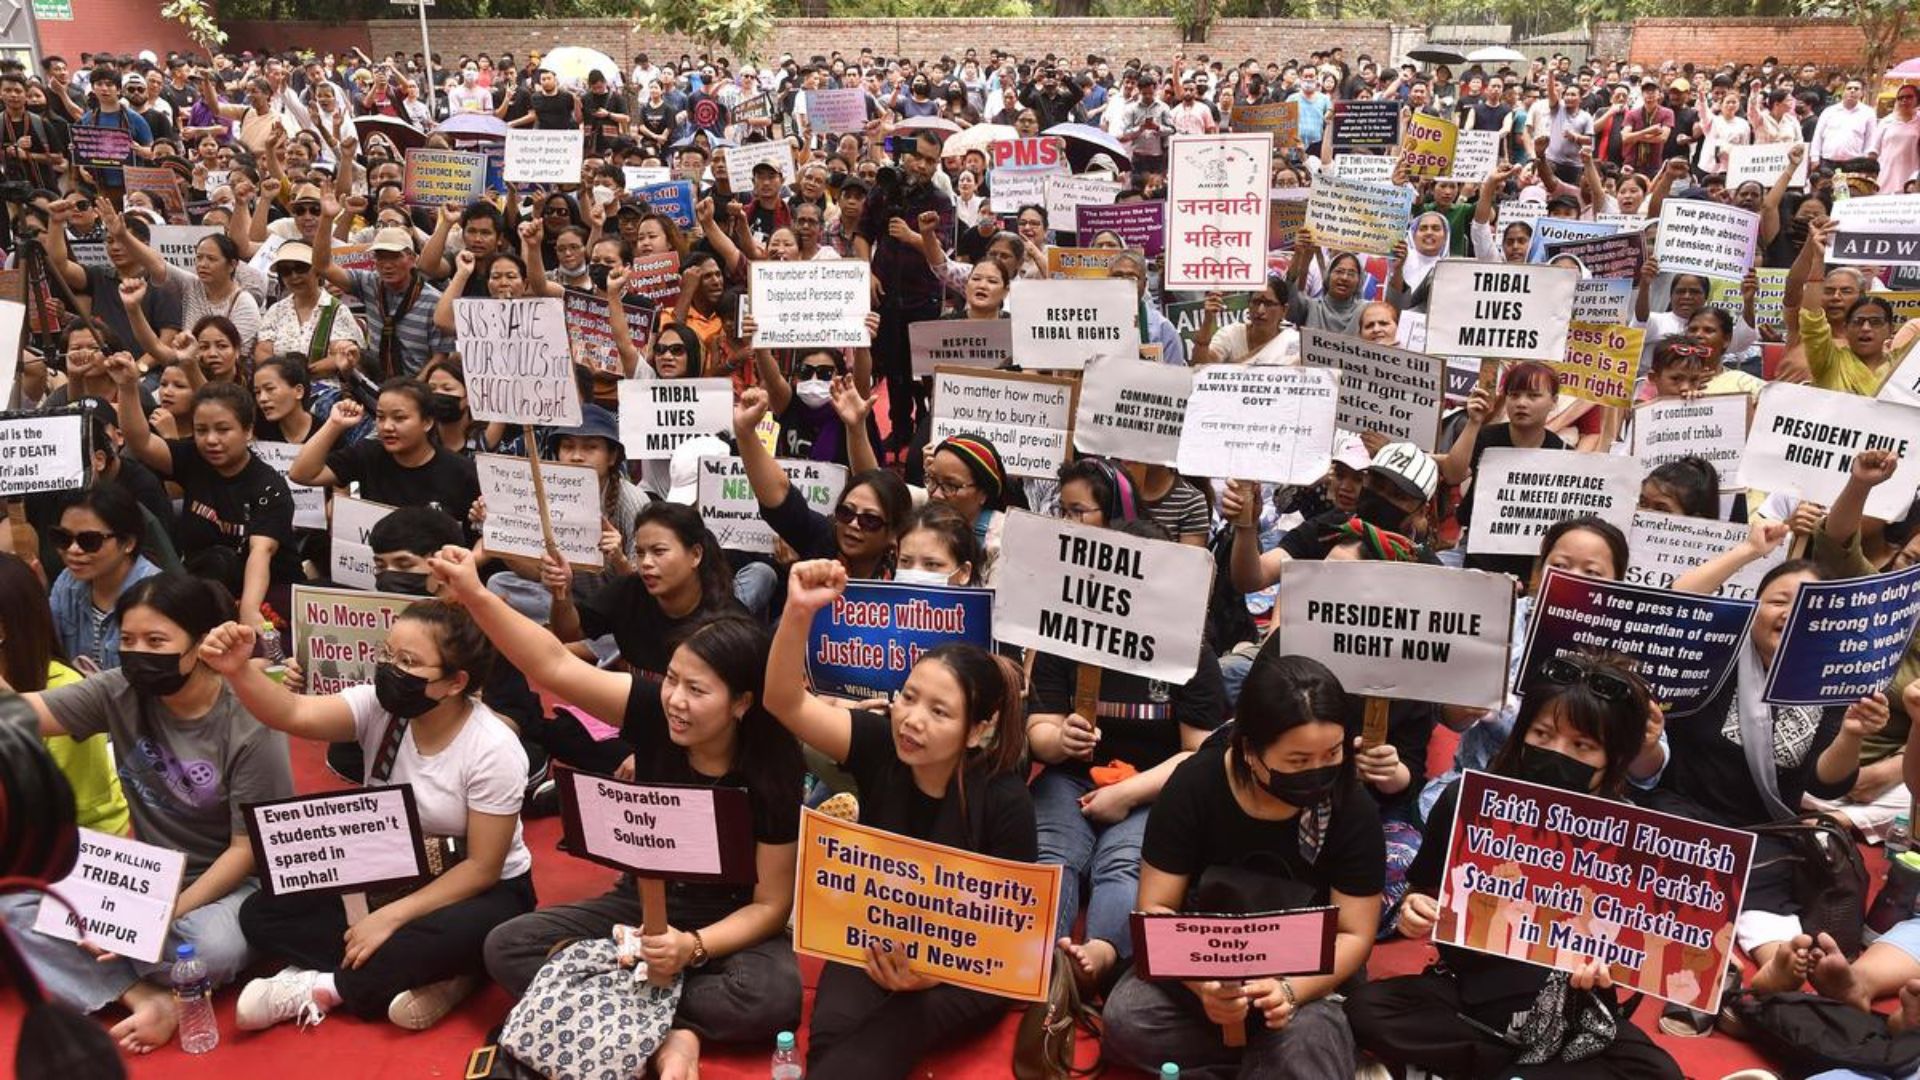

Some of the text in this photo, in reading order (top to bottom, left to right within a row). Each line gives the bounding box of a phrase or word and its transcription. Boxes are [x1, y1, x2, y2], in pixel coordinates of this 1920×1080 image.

[994, 137, 1058, 167] PMS
[1177, 192, 1261, 216] जनवादी
[1676, 206, 1696, 218] True
[1699, 210, 1726, 223] peace
[1728, 215, 1735, 224] is
[1184, 225, 1253, 248] महिला
[1666, 223, 1698, 236] merely
[1700, 225, 1716, 236] the
[633, 259, 673, 273] Freedom
[1182, 257, 1252, 280] समिति
[1660, 253, 1703, 266] presence
[1704, 258, 1713, 268] of
[758, 267, 864, 281] The number of Internally
[1473, 272, 1531, 293] TRIBAL
[767, 288, 807, 302] Displaced
[809, 288, 842, 300] Persons
[1047, 308, 1098, 321] RESPECT
[1475, 301, 1522, 320] LIVES
[1032, 326, 1121, 340] TRIBAL RIGHTS
[1458, 327, 1539, 349] MATTERS
[1312, 336, 1430, 373] Resistance till
[1307, 353, 1436, 391] our last breath!
[651, 386, 699, 403] TRIBAL
[942, 381, 1064, 405] No matter how much
[1368, 379, 1435, 408] fight for
[1585, 376, 1628, 399] right.
[657, 410, 694, 427] LIVES
[953, 406, 1036, 425] you try to bury
[1116, 416, 1154, 433] AGAINST
[1773, 416, 1861, 448] PRESIDENT
[20, 445, 57, 457] DEATH
[1, 478, 80, 492] Compensation
[1507, 472, 1605, 490] REMOVE/REPLACE
[1497, 489, 1613, 508] ALL MEETEI OFFICERS
[1500, 506, 1574, 521] COMMANDING
[1490, 522, 1520, 535] ARMY
[1058, 534, 1144, 580] TRIBAL
[1062, 575, 1132, 617] LIVES
[1808, 585, 1909, 609] It is the duty
[307, 602, 376, 628] No More
[832, 594, 965, 633] Peace without
[1307, 600, 1480, 636] PRESIDENT RULE
[1606, 595, 1634, 611] free
[1636, 602, 1674, 619] press
[1676, 605, 1689, 618] is
[1691, 607, 1714, 622] the
[1548, 605, 1737, 647] unsleeping guardian of every
[1808, 612, 1888, 635] strong to
[1038, 610, 1156, 662] MATTERS
[1572, 629, 1704, 661] other right that free
[311, 638, 352, 661] More
[818, 634, 905, 671] Justice is
[1332, 634, 1451, 663] RIGHT NOW
[1821, 656, 1888, 678] protect
[597, 782, 681, 807] Separation
[263, 796, 379, 825] Even University
[624, 810, 656, 829] Only
[269, 816, 399, 846] students weren't
[613, 828, 675, 849] Solution
[1480, 789, 1735, 873] Faith Should Flourish
[80, 842, 161, 873] STOP KILLING
[275, 845, 345, 869] spared in
[82, 864, 150, 895] TRIBALS
[279, 869, 339, 891] Imphal!
[818, 836, 1037, 906] "Fairness, Integrity,
[1467, 826, 1725, 912] Violence Must Perish:
[101, 896, 115, 913] in
[817, 869, 1034, 932] and Accountability:
[1463, 864, 1713, 950] Stand with Christians
[65, 914, 138, 944] MANIPUR
[867, 905, 977, 948] Challenge
[1175, 922, 1280, 935] Separation
[1207, 938, 1249, 951] Only
[1549, 922, 1646, 971] Manipur
[1190, 952, 1267, 963] Solution
